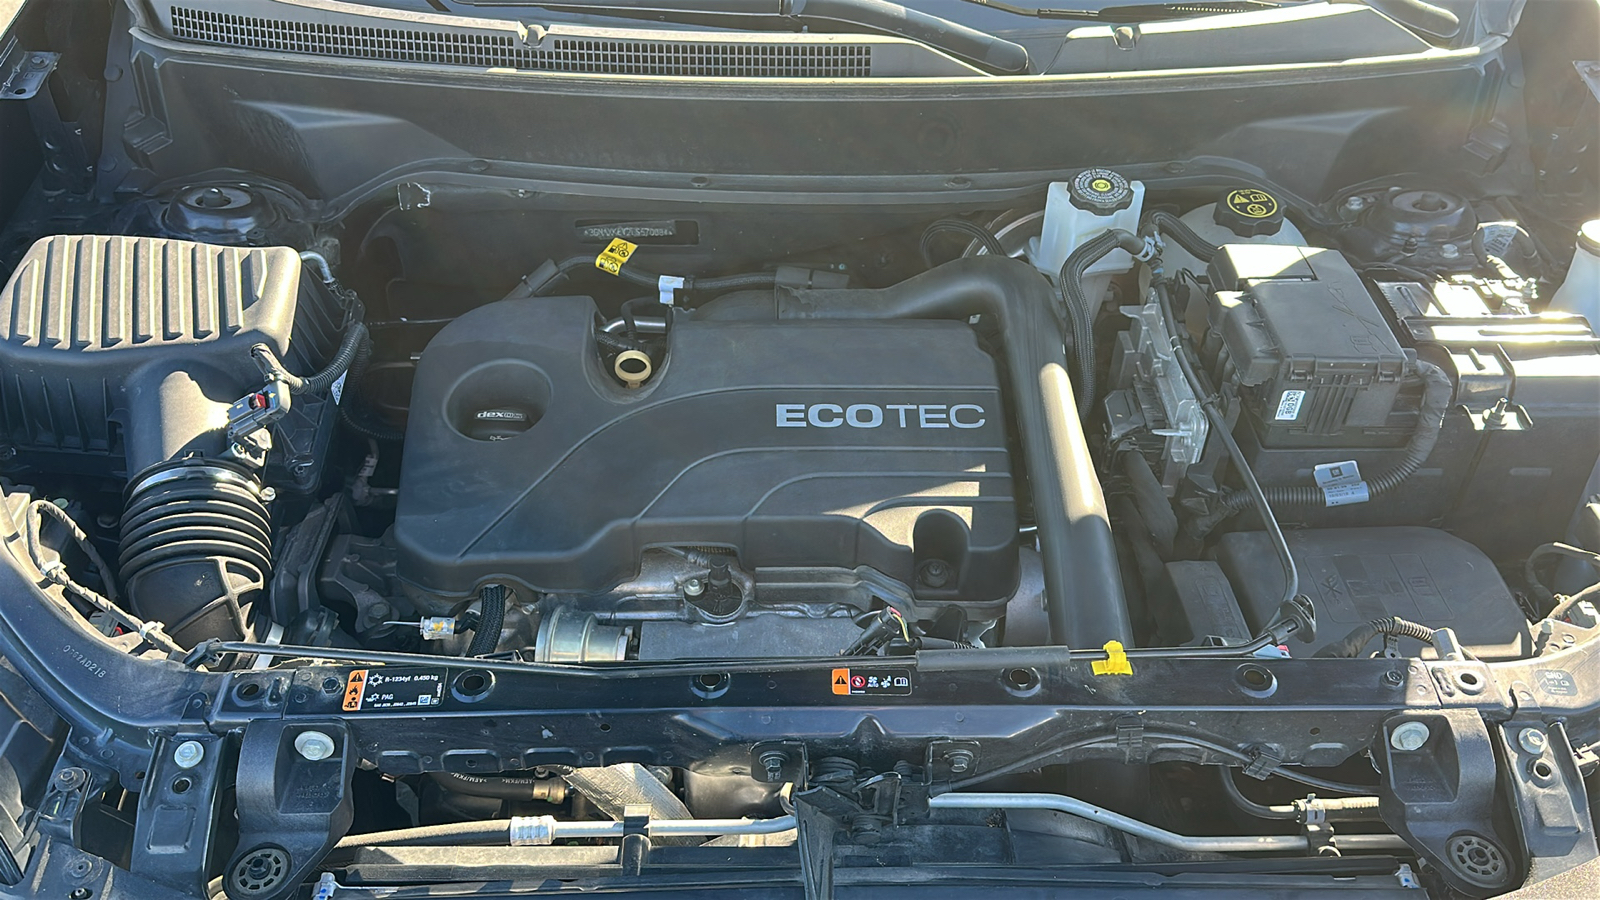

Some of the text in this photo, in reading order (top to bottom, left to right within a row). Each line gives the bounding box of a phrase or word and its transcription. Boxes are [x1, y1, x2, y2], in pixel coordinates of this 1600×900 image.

[477, 411, 523, 419] dexos
[776, 403, 986, 428] ECOTEC
[431, 674, 439, 682] kg
